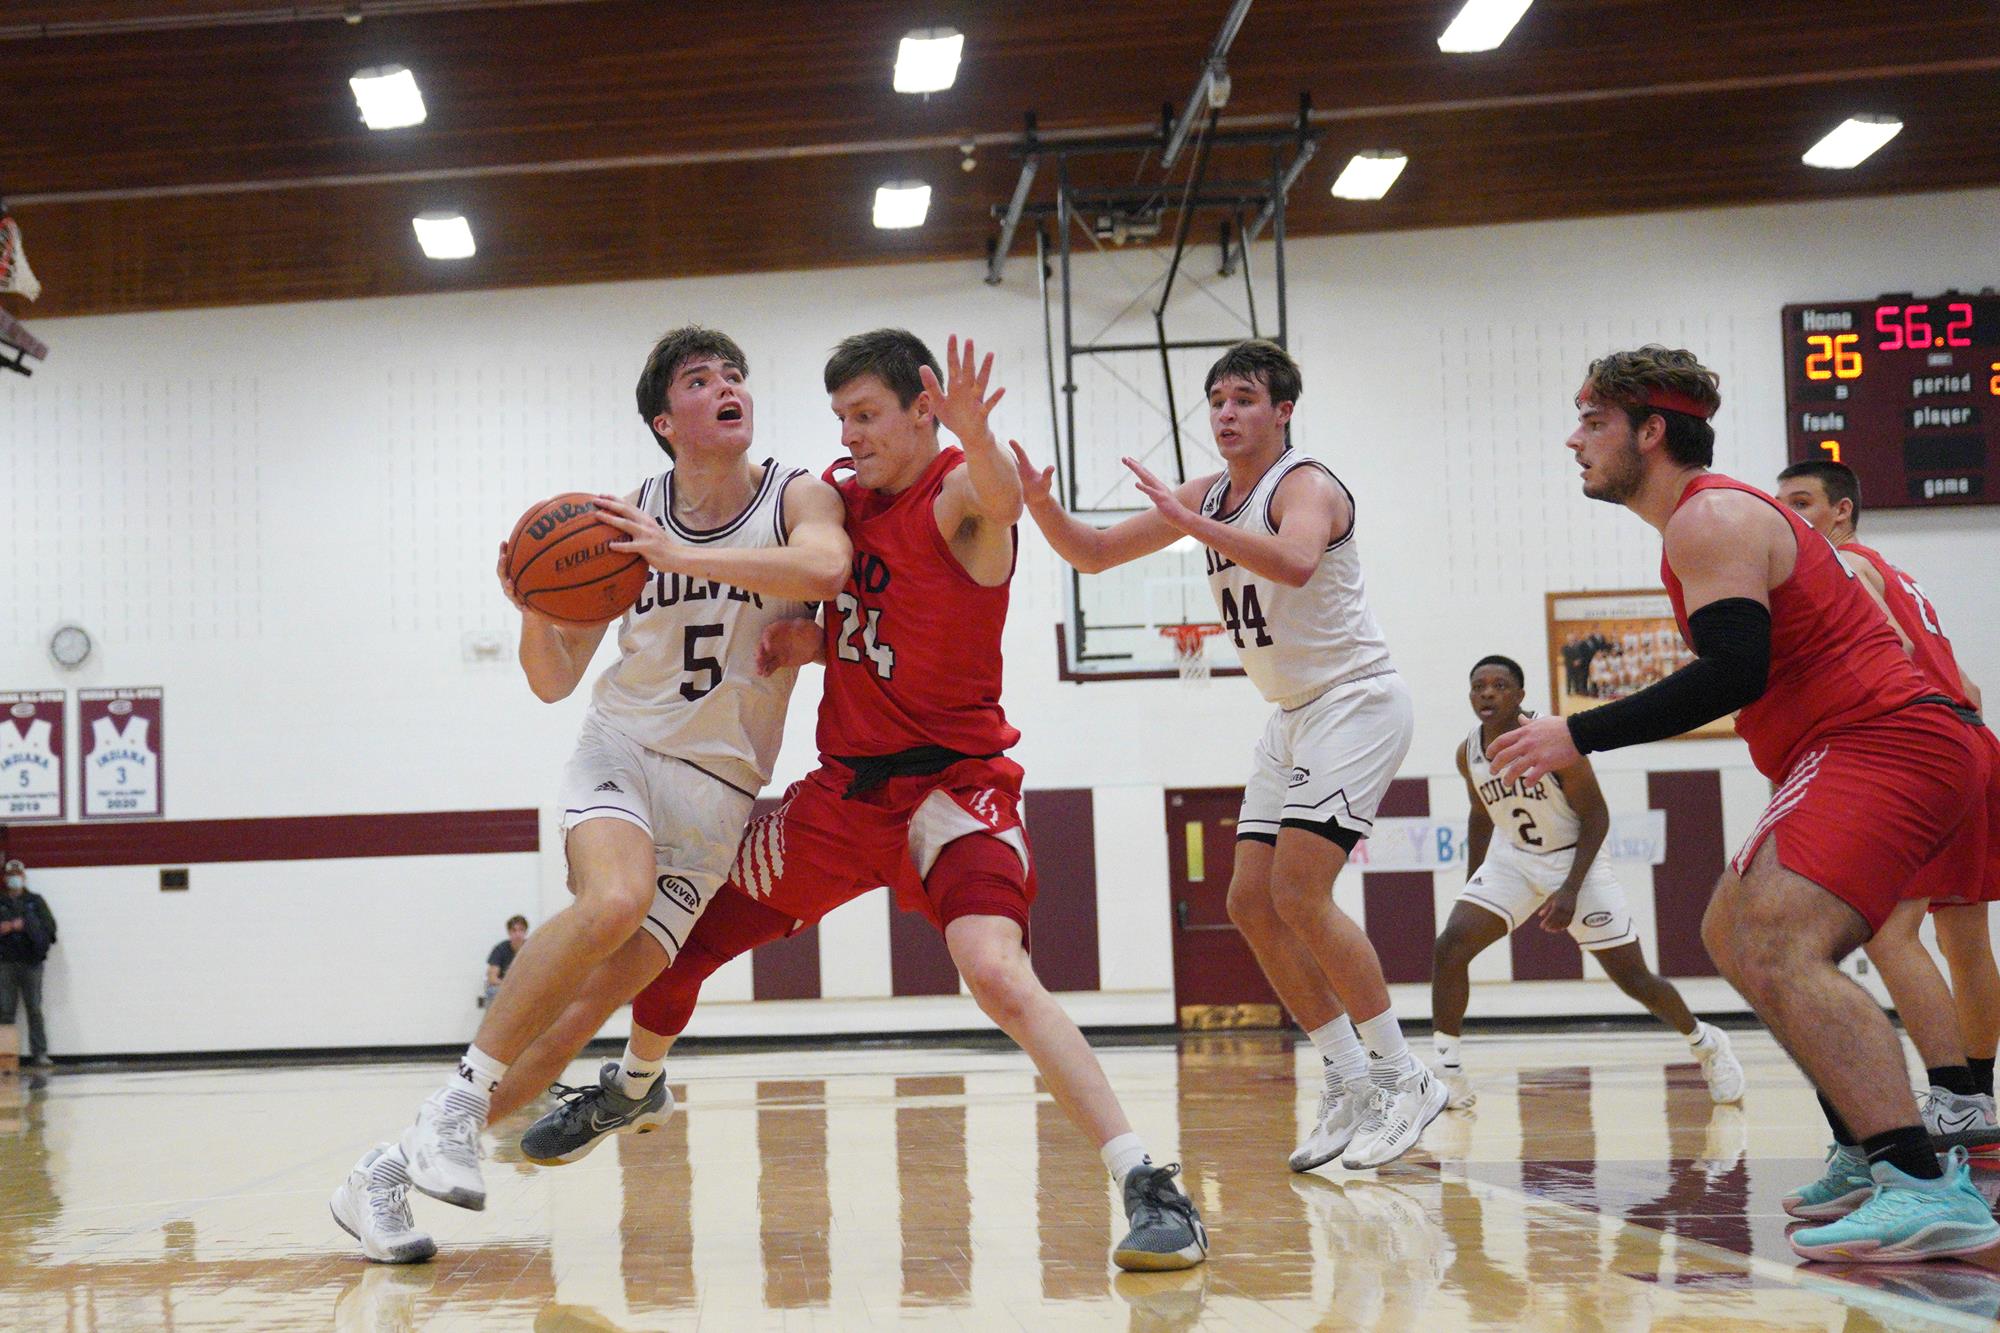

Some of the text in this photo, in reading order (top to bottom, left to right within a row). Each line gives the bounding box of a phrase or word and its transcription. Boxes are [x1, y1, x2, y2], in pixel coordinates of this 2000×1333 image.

[1875, 303, 1973, 350] 56.2
[1805, 333, 1863, 380] 26
[1912, 373, 1971, 398] period
[1912, 406, 1971, 429] player
[635, 569, 763, 610] CULVE
[835, 590, 895, 681] 24
[1221, 583, 1274, 649] 44
[679, 623, 724, 702] 5
[19, 769, 30, 788] 5
[116, 766, 127, 784] 3
[1512, 807, 1543, 847] 2
